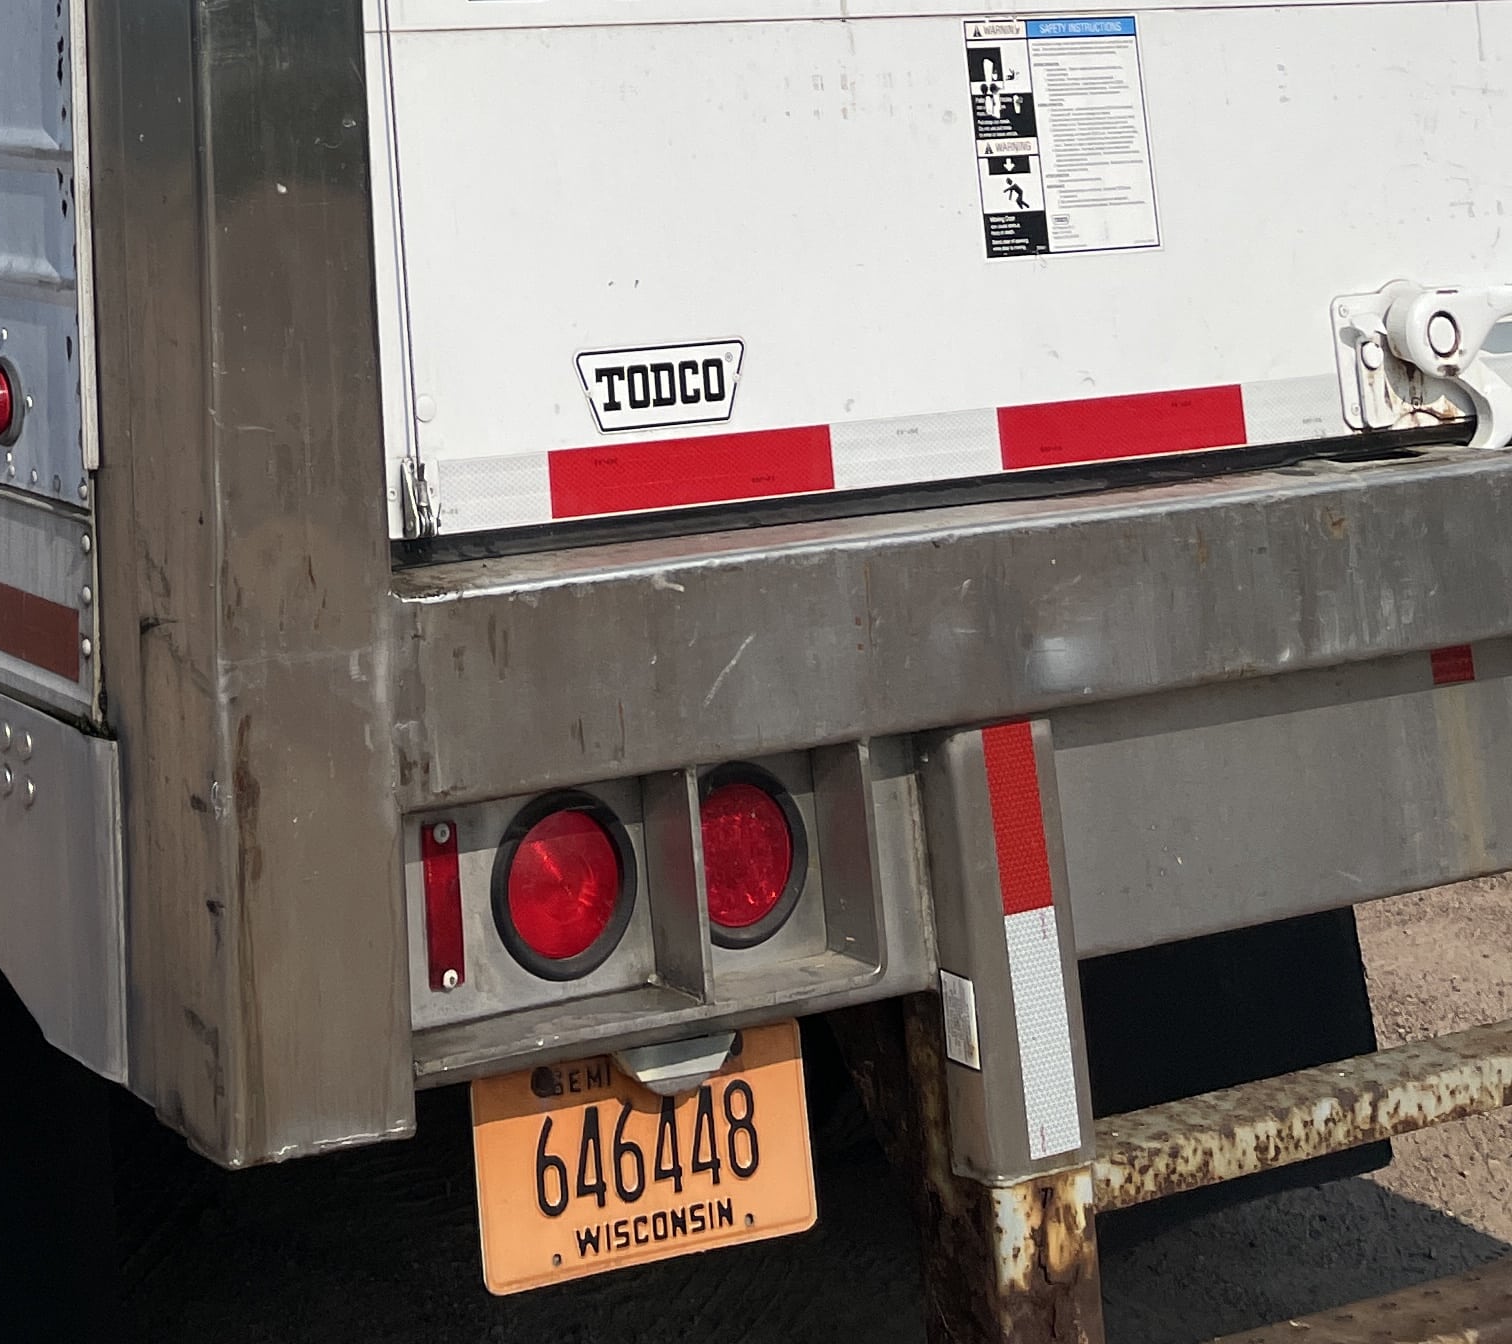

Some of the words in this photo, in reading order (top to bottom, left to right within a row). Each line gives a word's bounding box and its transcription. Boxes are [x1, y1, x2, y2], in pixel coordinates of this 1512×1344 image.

[1039, 23, 1067, 34] SAFETY
[1068, 21, 1122, 32] INSTRUCTIONS
[995, 141, 1032, 152] WARNING
[595, 357, 726, 412] TODCO
[536, 1079, 759, 1217] 646448
[576, 1198, 734, 1257] WISCONSIN
